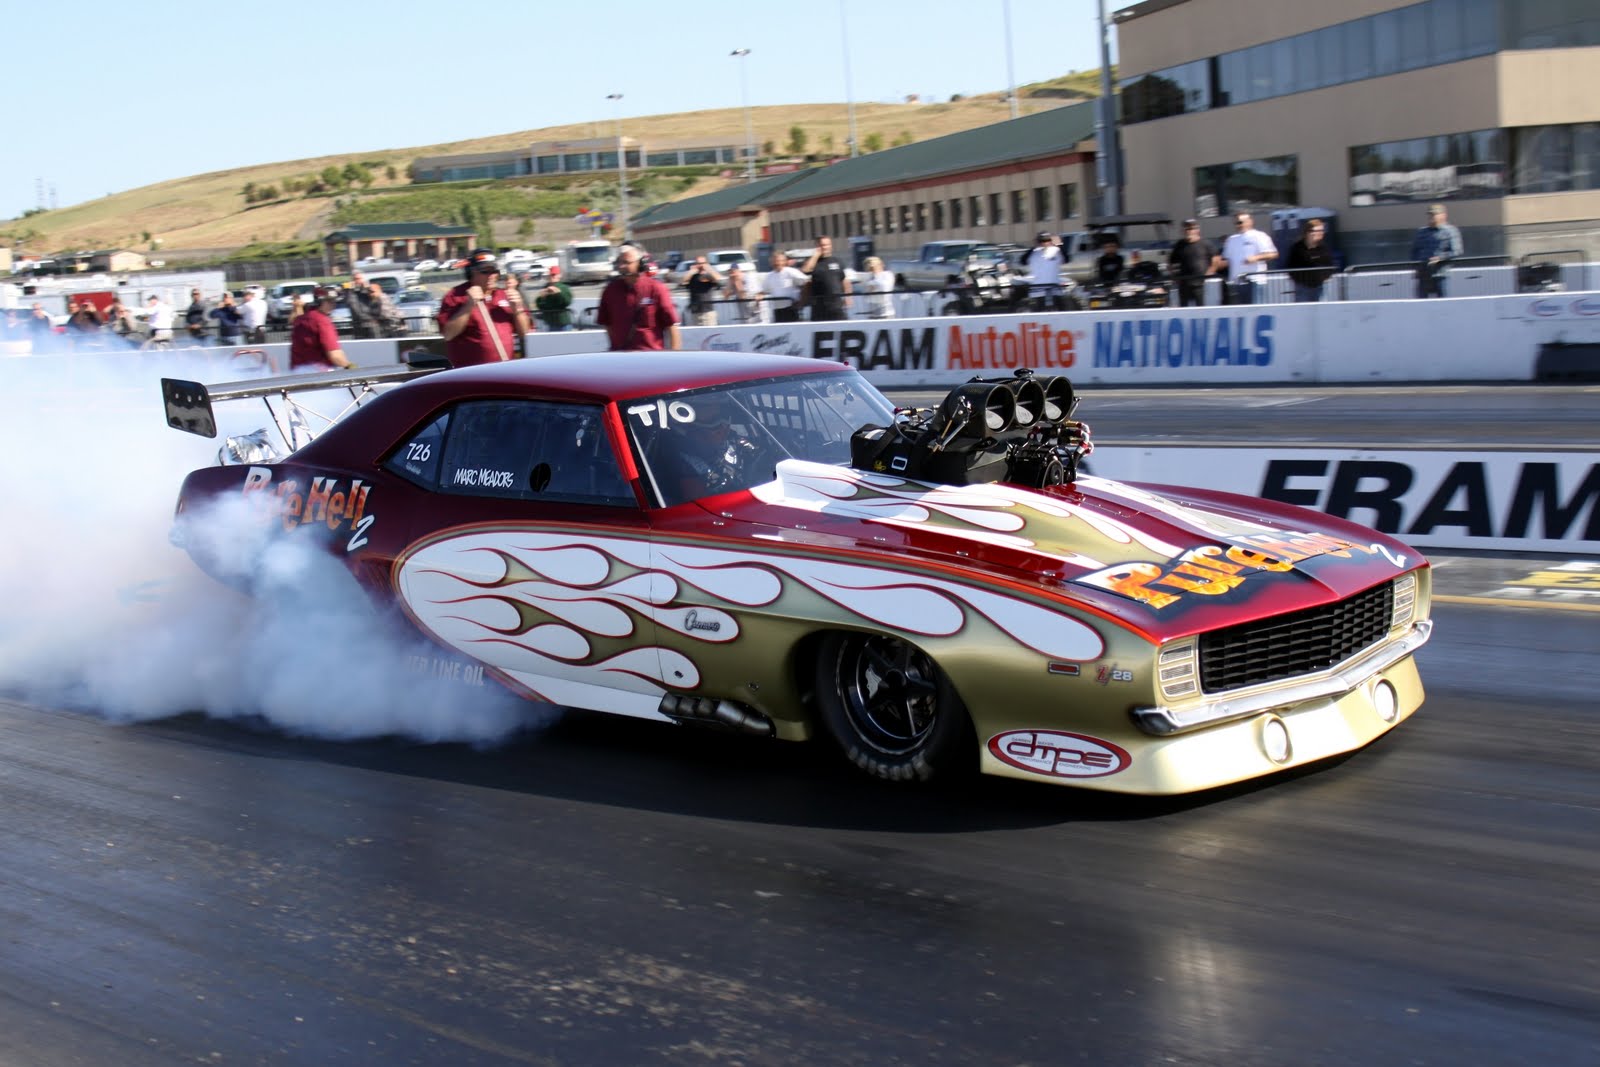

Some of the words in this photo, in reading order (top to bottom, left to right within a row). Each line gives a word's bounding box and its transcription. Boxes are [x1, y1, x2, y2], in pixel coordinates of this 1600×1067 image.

[812, 327, 936, 371] FRAM
[948, 322, 1076, 371] Autolite
[1093, 315, 1274, 368] NATIONALS
[406, 442, 431, 462] 726
[453, 467, 478, 486] MARC
[477, 468, 514, 488] MEADORS
[1259, 459, 1600, 542] FRAM
[346, 514, 375, 552] 2
[1370, 543, 1407, 568] 2
[463, 664, 485, 686] OIL
